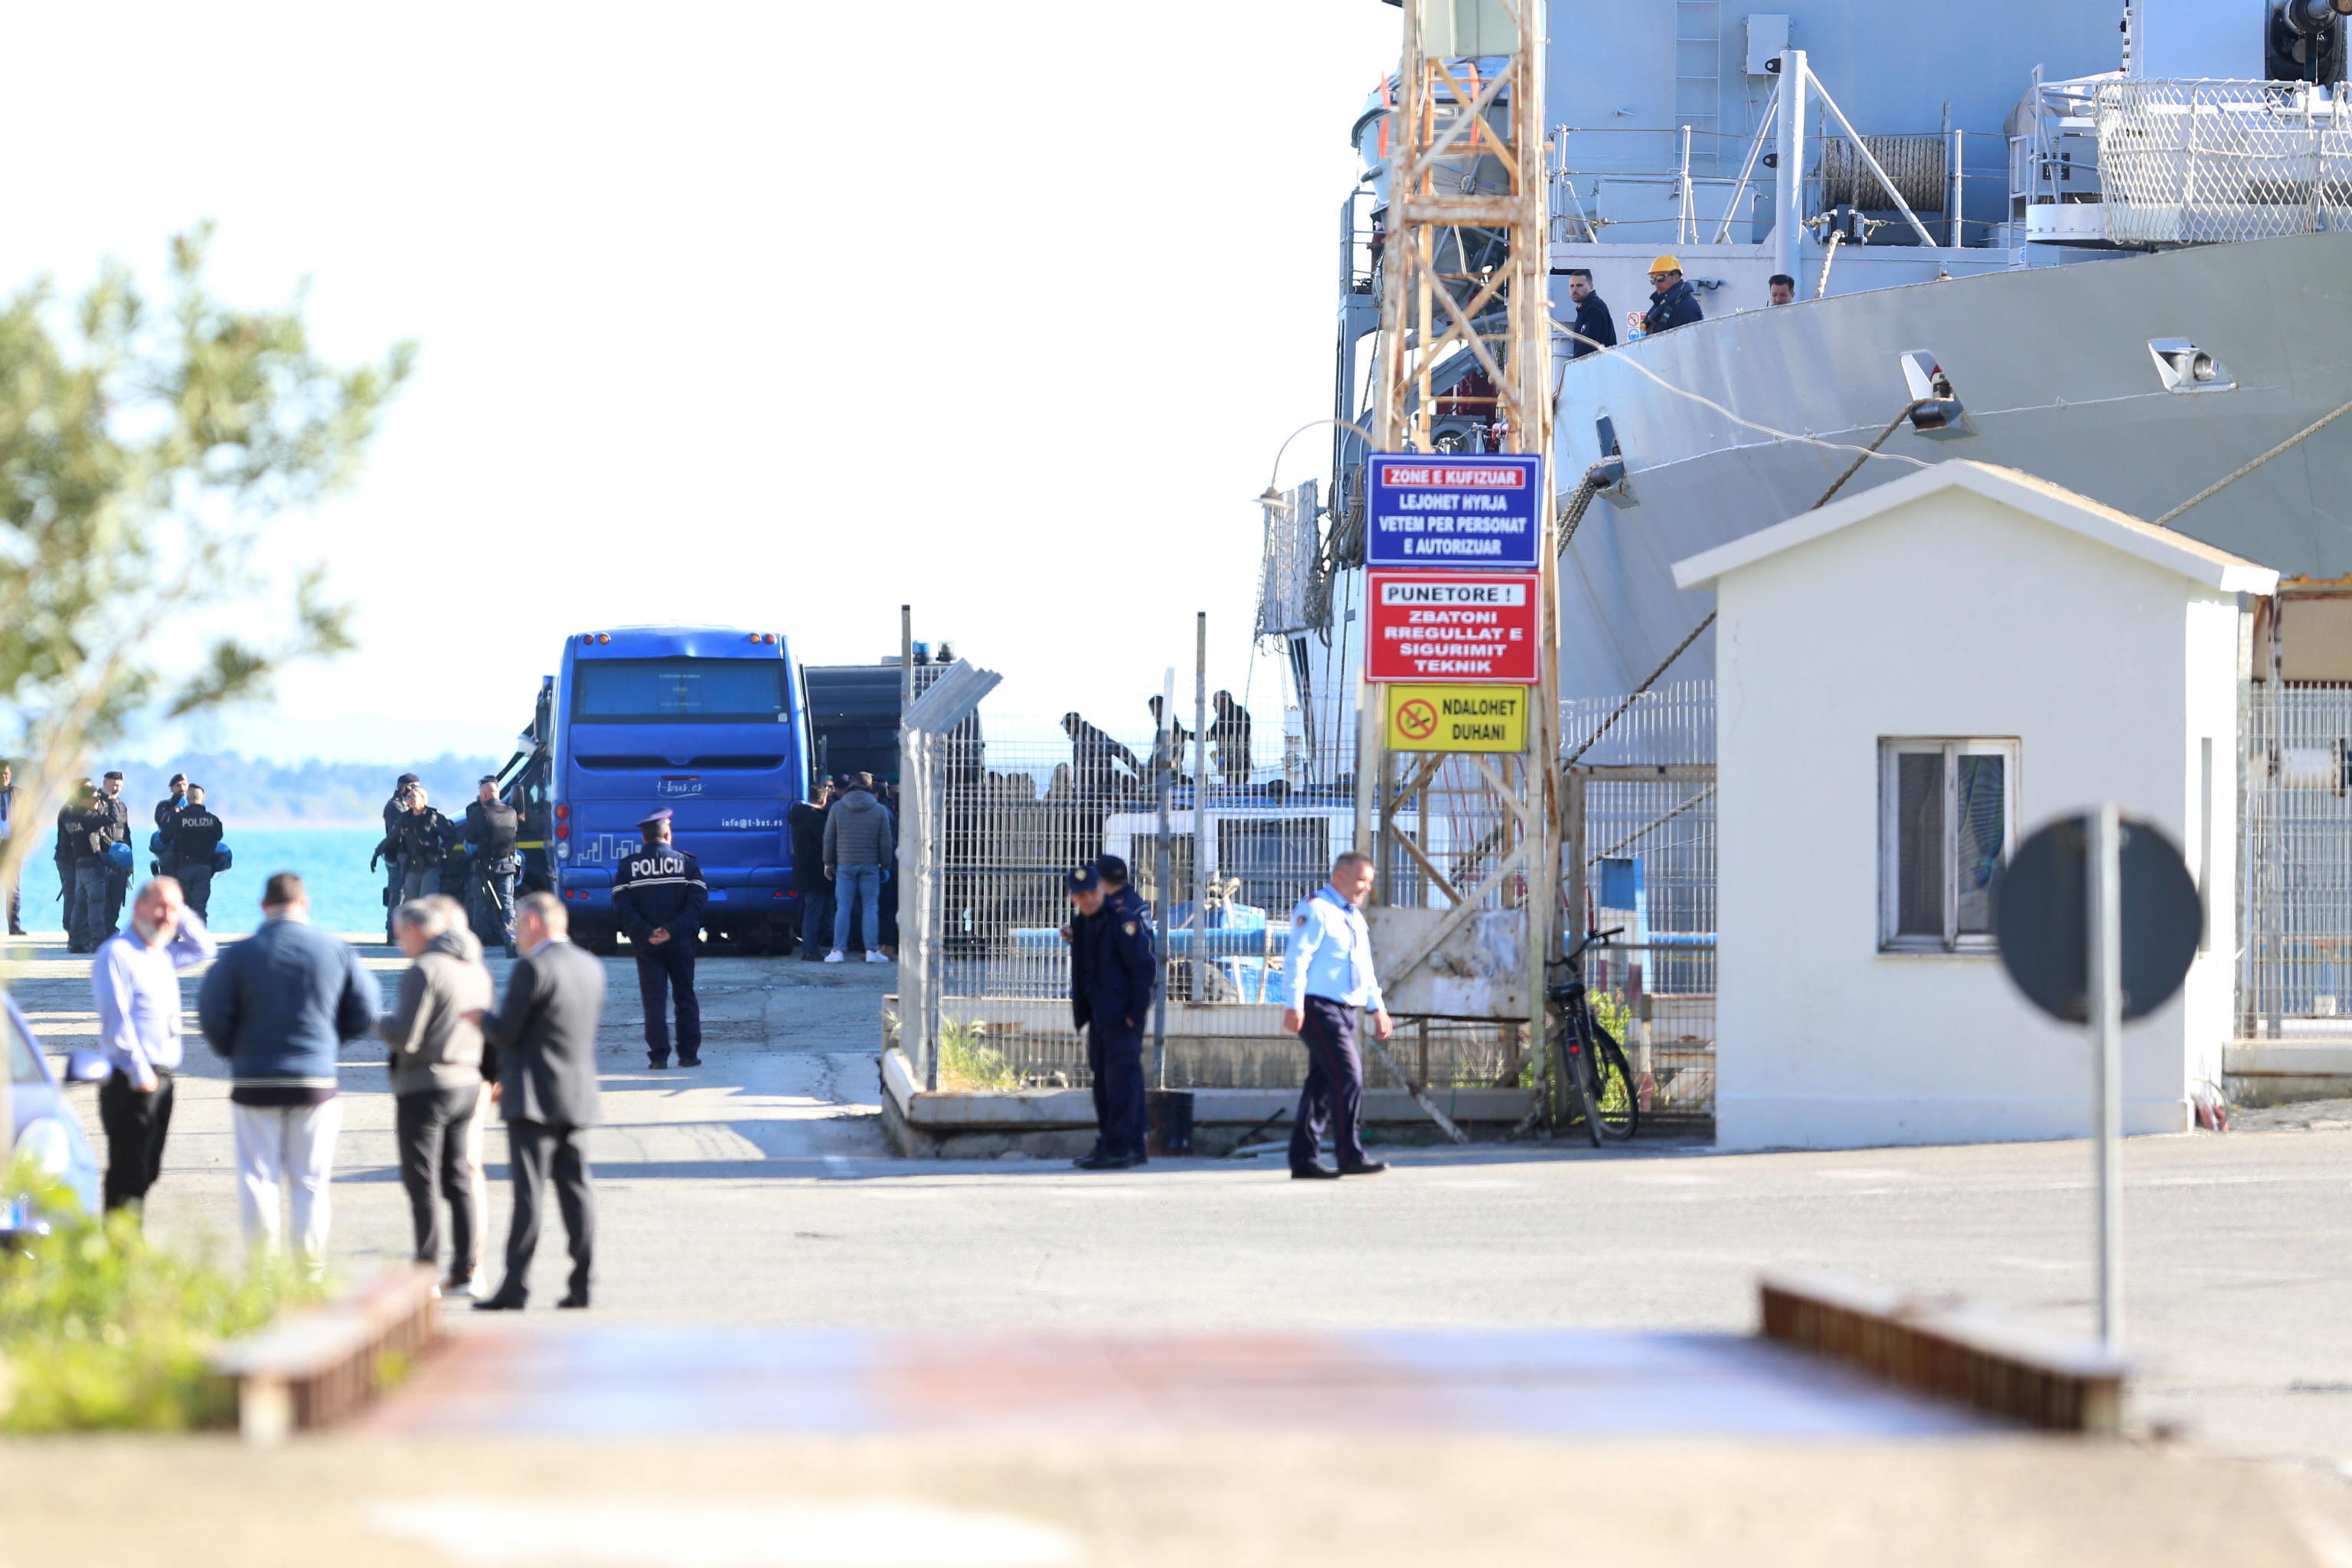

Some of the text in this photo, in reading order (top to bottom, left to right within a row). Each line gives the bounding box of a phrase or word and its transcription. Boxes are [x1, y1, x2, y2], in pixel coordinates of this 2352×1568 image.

[1390, 469, 1517, 485] ZONE E KUFIZUAR
[1400, 494, 1508, 511] LEJOHET HYRJA
[1379, 515, 1527, 534] VETEM PER PERSONAT
[1404, 537, 1503, 555] E AUTORIZUAR
[1388, 587, 1499, 602] PUNETORE
[1409, 610, 1498, 624] ZBATONI
[1384, 626, 1524, 641] RREGULLAT E
[1400, 643, 1507, 657] SIGURIMIT
[1414, 659, 1492, 673] TEKNIK
[1442, 698, 1516, 715] NDALOHET
[1453, 724, 1505, 740] DUHANI
[655, 780, 707, 792] t-bus.es
[181, 818, 214, 828] POLIZIA
[721, 818, 782, 828] info@t-bus.es
